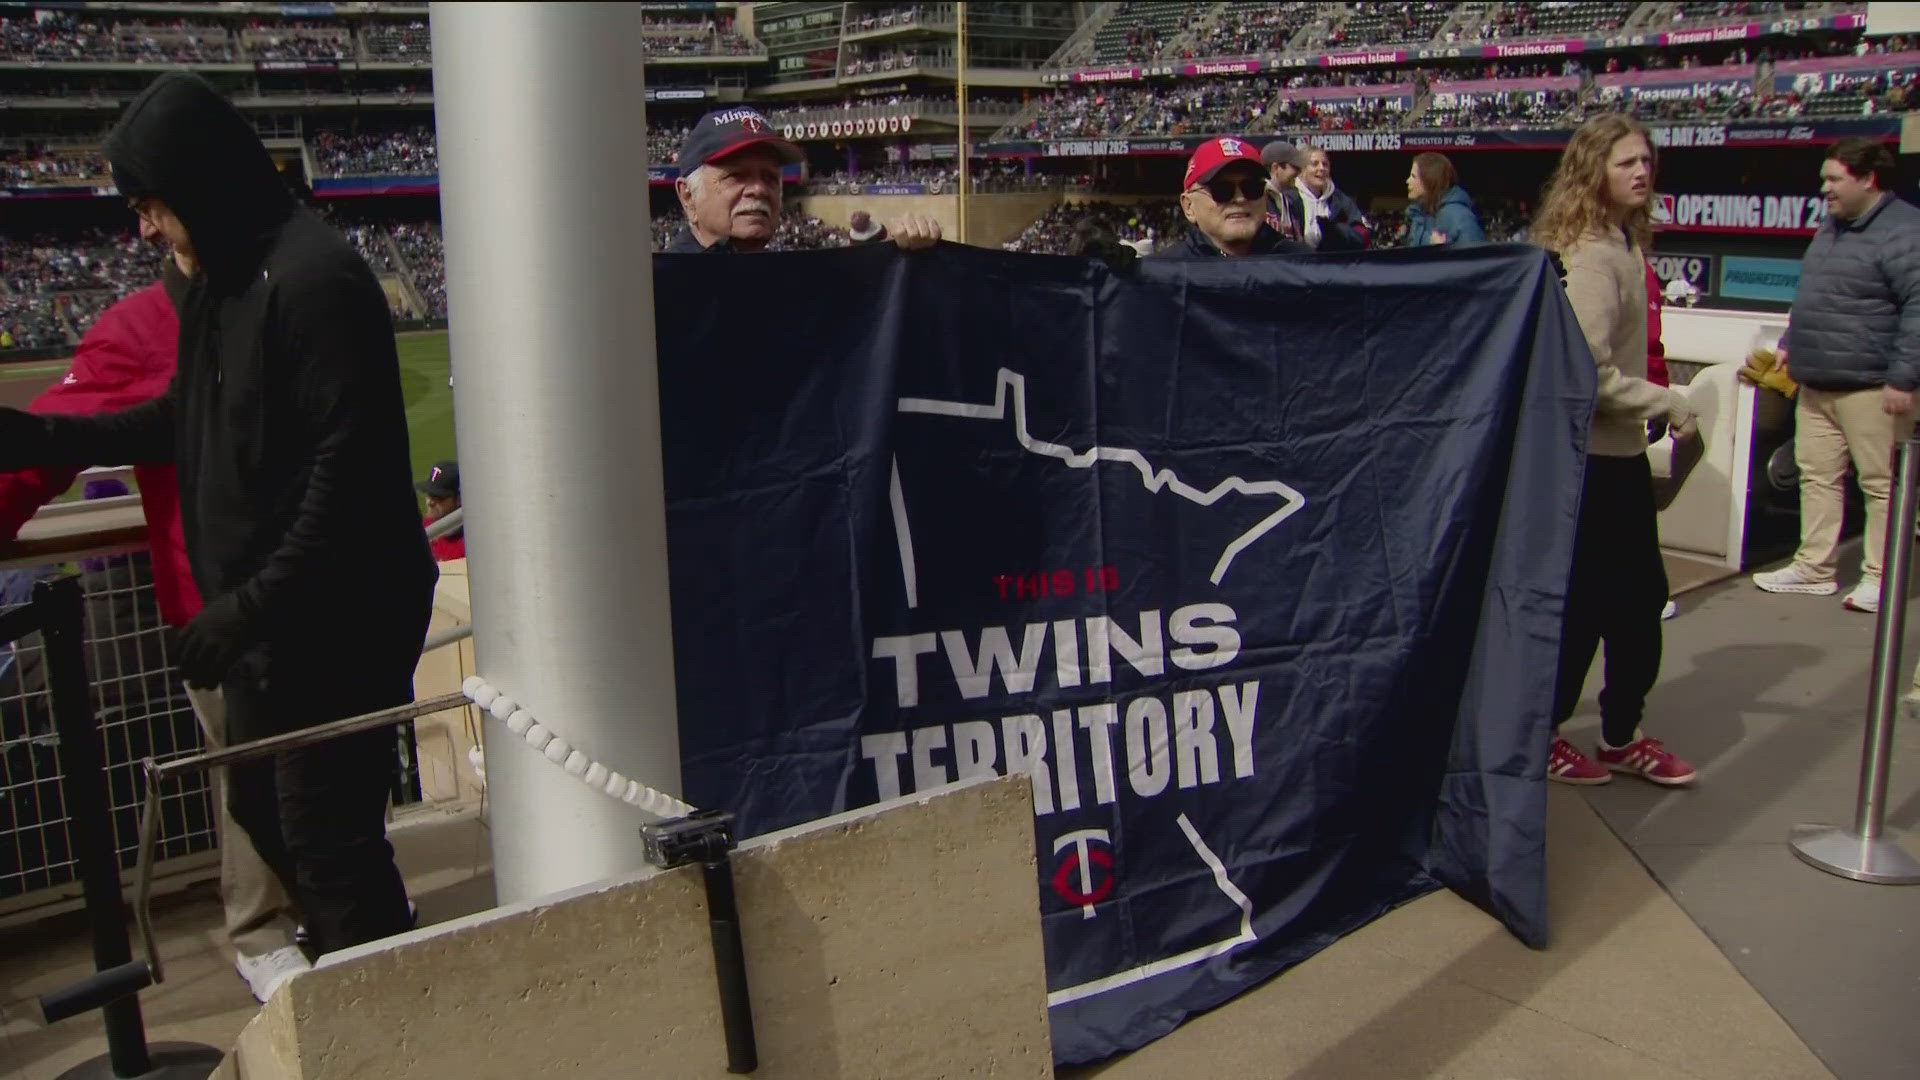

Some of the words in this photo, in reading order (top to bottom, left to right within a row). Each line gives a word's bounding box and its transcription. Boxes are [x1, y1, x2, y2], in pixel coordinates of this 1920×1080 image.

[1666, 31, 1712, 45] Treasure
[1713, 26, 1747, 40] Island
[1327, 54, 1367, 67] Treasure
[1368, 53, 1396, 64] Island
[1079, 71, 1110, 82] Treasure
[1111, 69, 1132, 80] Island
[1311, 135, 1354, 150] OPENING
[1354, 135, 1375, 150] DAY
[1375, 134, 1401, 150] 2025
[1405, 137, 1442, 146] PRESENTED
[1443, 137, 1453, 145] BY
[1454, 135, 1476, 146] Ford
[1671, 127, 1695, 146] DAY
[1695, 126, 1726, 146] 2025
[1787, 126, 1815, 140] Ford
[1060, 142, 1093, 156] OPENING
[1093, 141, 1109, 155] DAY
[1109, 141, 1129, 155] 2025
[1168, 141, 1185, 151] Ford
[1676, 194, 1761, 228] OPENING
[1763, 195, 1806, 229] DAY
[1687, 258, 1703, 283] 9
[992, 568, 1075, 601] THIS
[1085, 565, 1120, 594] IS
[872, 602, 1242, 709] TWINS
[861, 680, 1260, 818] TERRITORY
